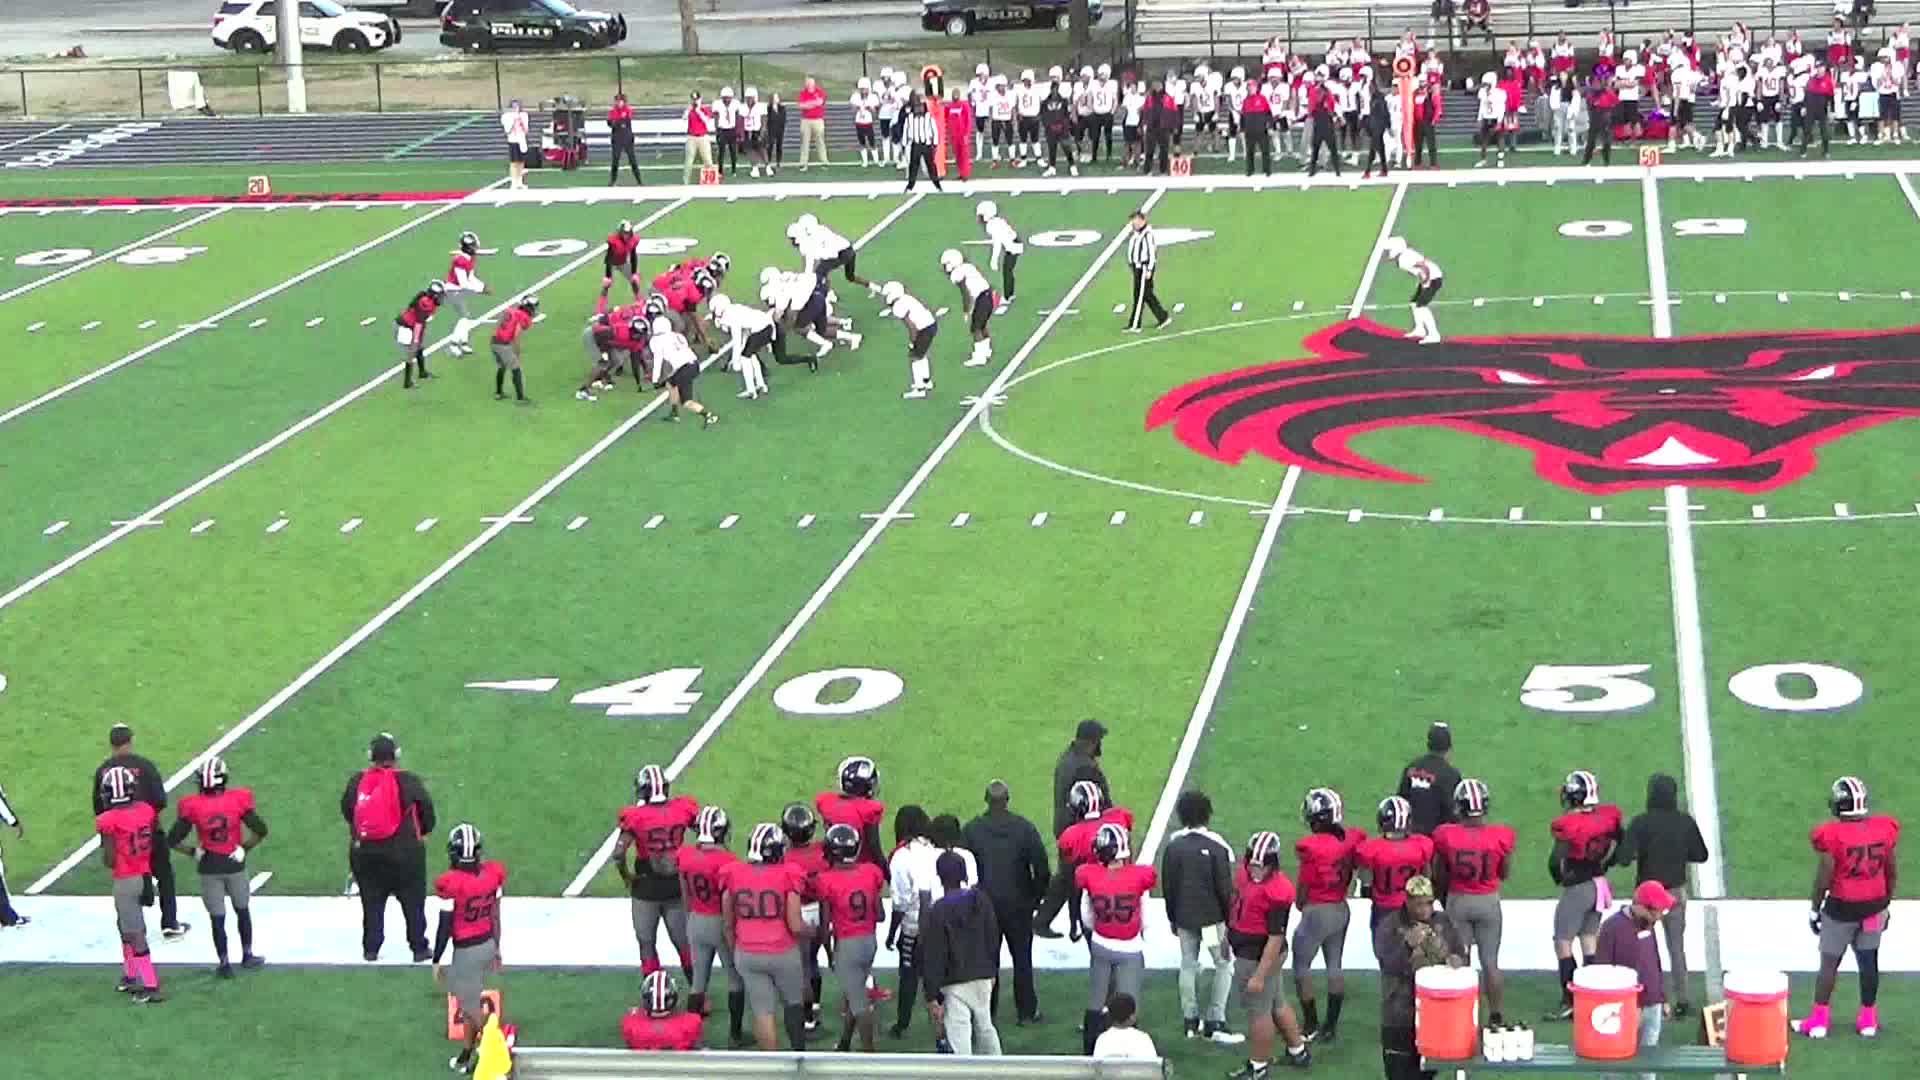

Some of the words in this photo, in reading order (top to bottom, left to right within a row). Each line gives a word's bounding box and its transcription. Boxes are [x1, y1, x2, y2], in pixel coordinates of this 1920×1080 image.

[1172, 160, 1189, 174] 40
[1641, 150, 1657, 165] 50
[249, 179, 265, 194] 20
[1453, 850, 1491, 877] 51
[734, 889, 783, 919] 60
[849, 890, 868, 921] 9
